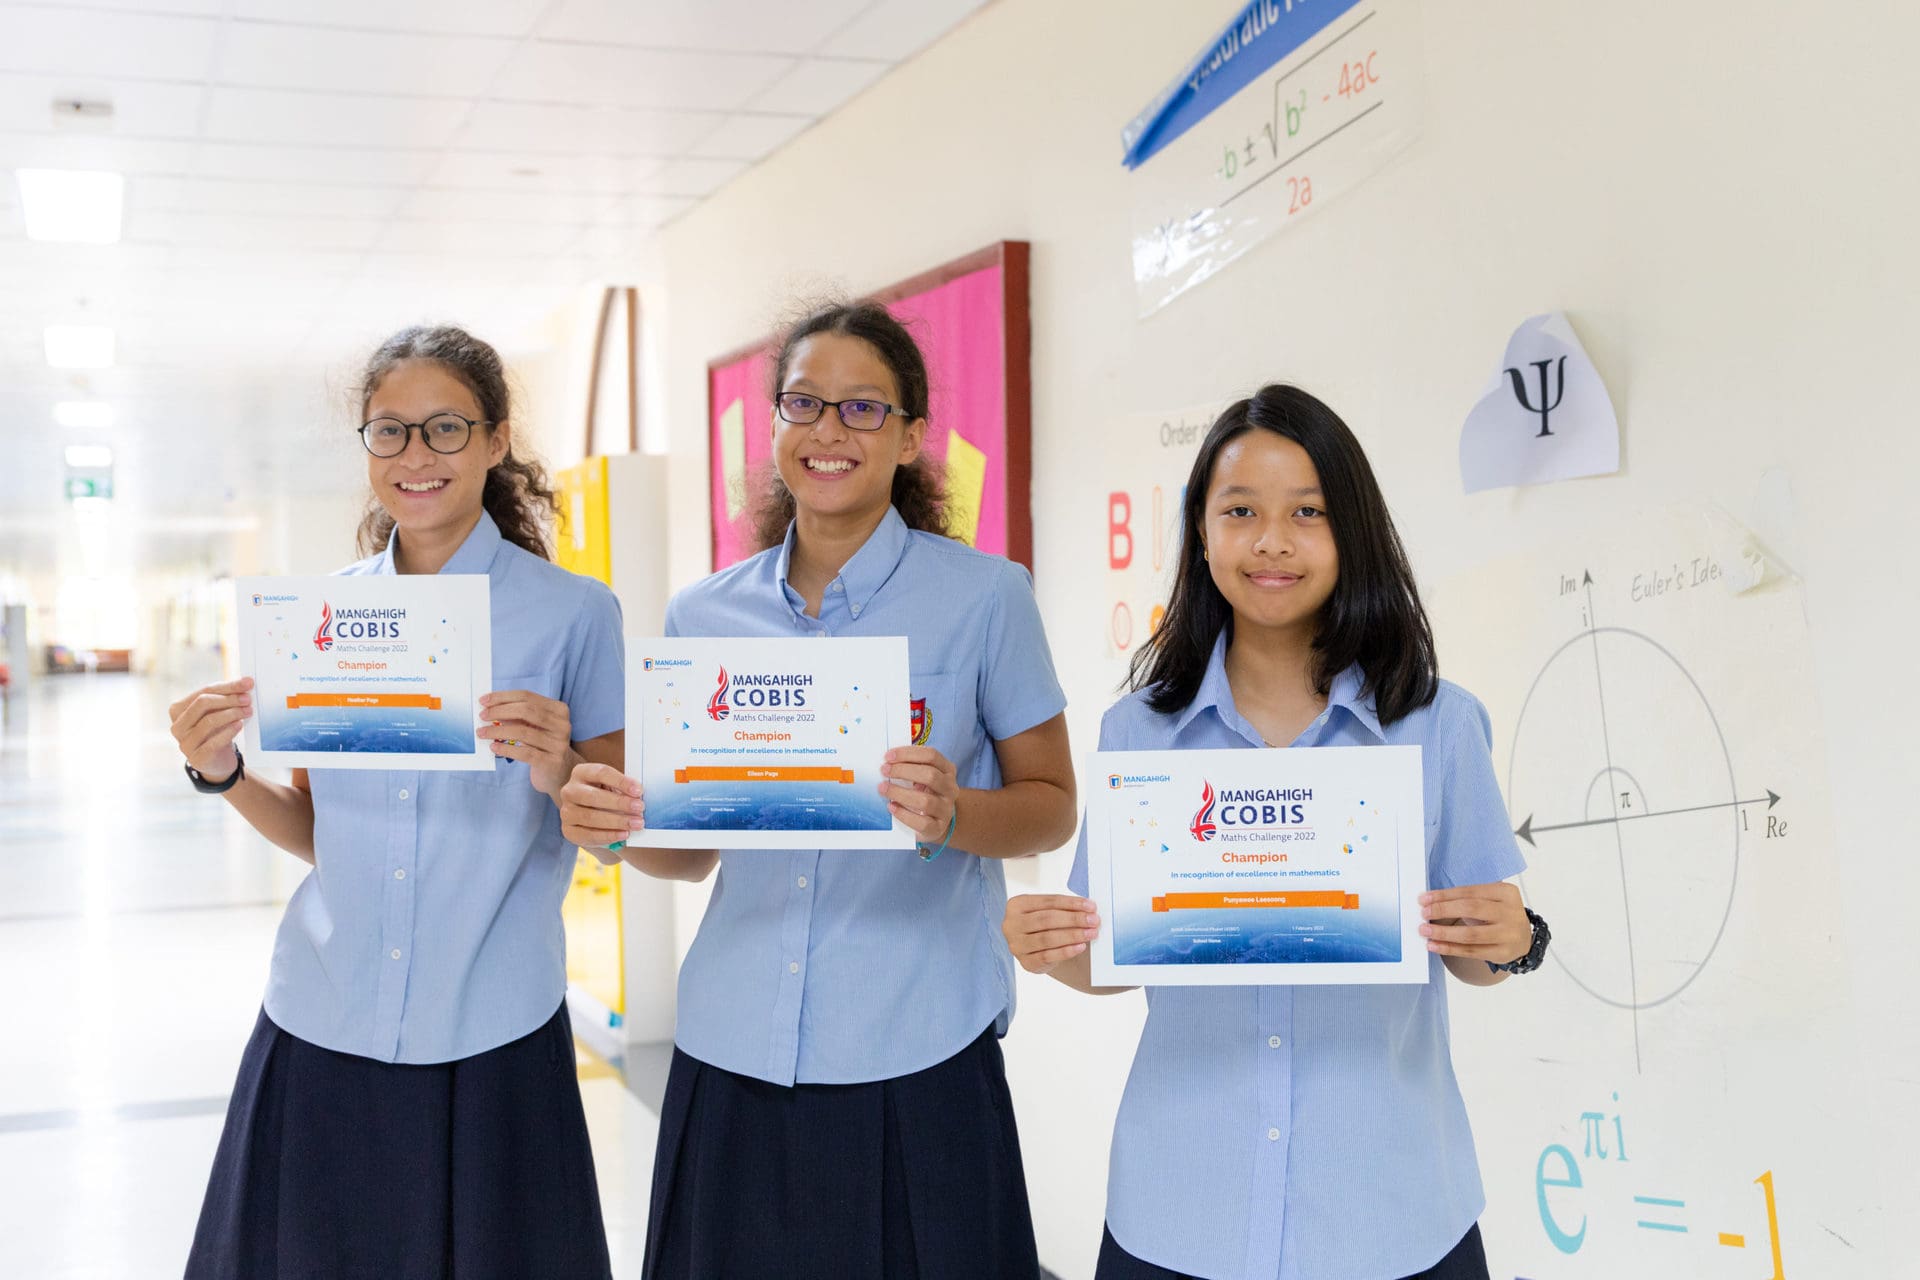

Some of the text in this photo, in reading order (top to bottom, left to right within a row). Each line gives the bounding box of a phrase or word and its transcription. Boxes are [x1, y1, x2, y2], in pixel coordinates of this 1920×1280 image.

[1287, 176, 1313, 215] 2a
[1160, 418, 1199, 447] Order
[1560, 574, 1577, 596] Im
[1631, 555, 1722, 602] Euler's Ide
[336, 608, 407, 619] MANGAHIGH
[336, 622, 400, 638] COBIS
[336, 644, 408, 654] Maths Challenge 2022
[337, 660, 388, 672] Champion
[733, 675, 813, 686] MANGAHIGH
[733, 689, 806, 707] COBIS
[733, 714, 815, 723] Maths Challenge 2022
[734, 731, 791, 743] Champion
[699, 747, 737, 755] recognition
[1220, 789, 1313, 802] MANGAHIGH
[1221, 804, 1305, 825] COBIS
[1766, 815, 1788, 838] Re
[1220, 831, 1316, 843] Maths Challenge 2022
[1222, 852, 1288, 865] Champion
[1180, 871, 1224, 880] recognition
[1226, 870, 1234, 878] of
[1288, 868, 1340, 877] mathematics
